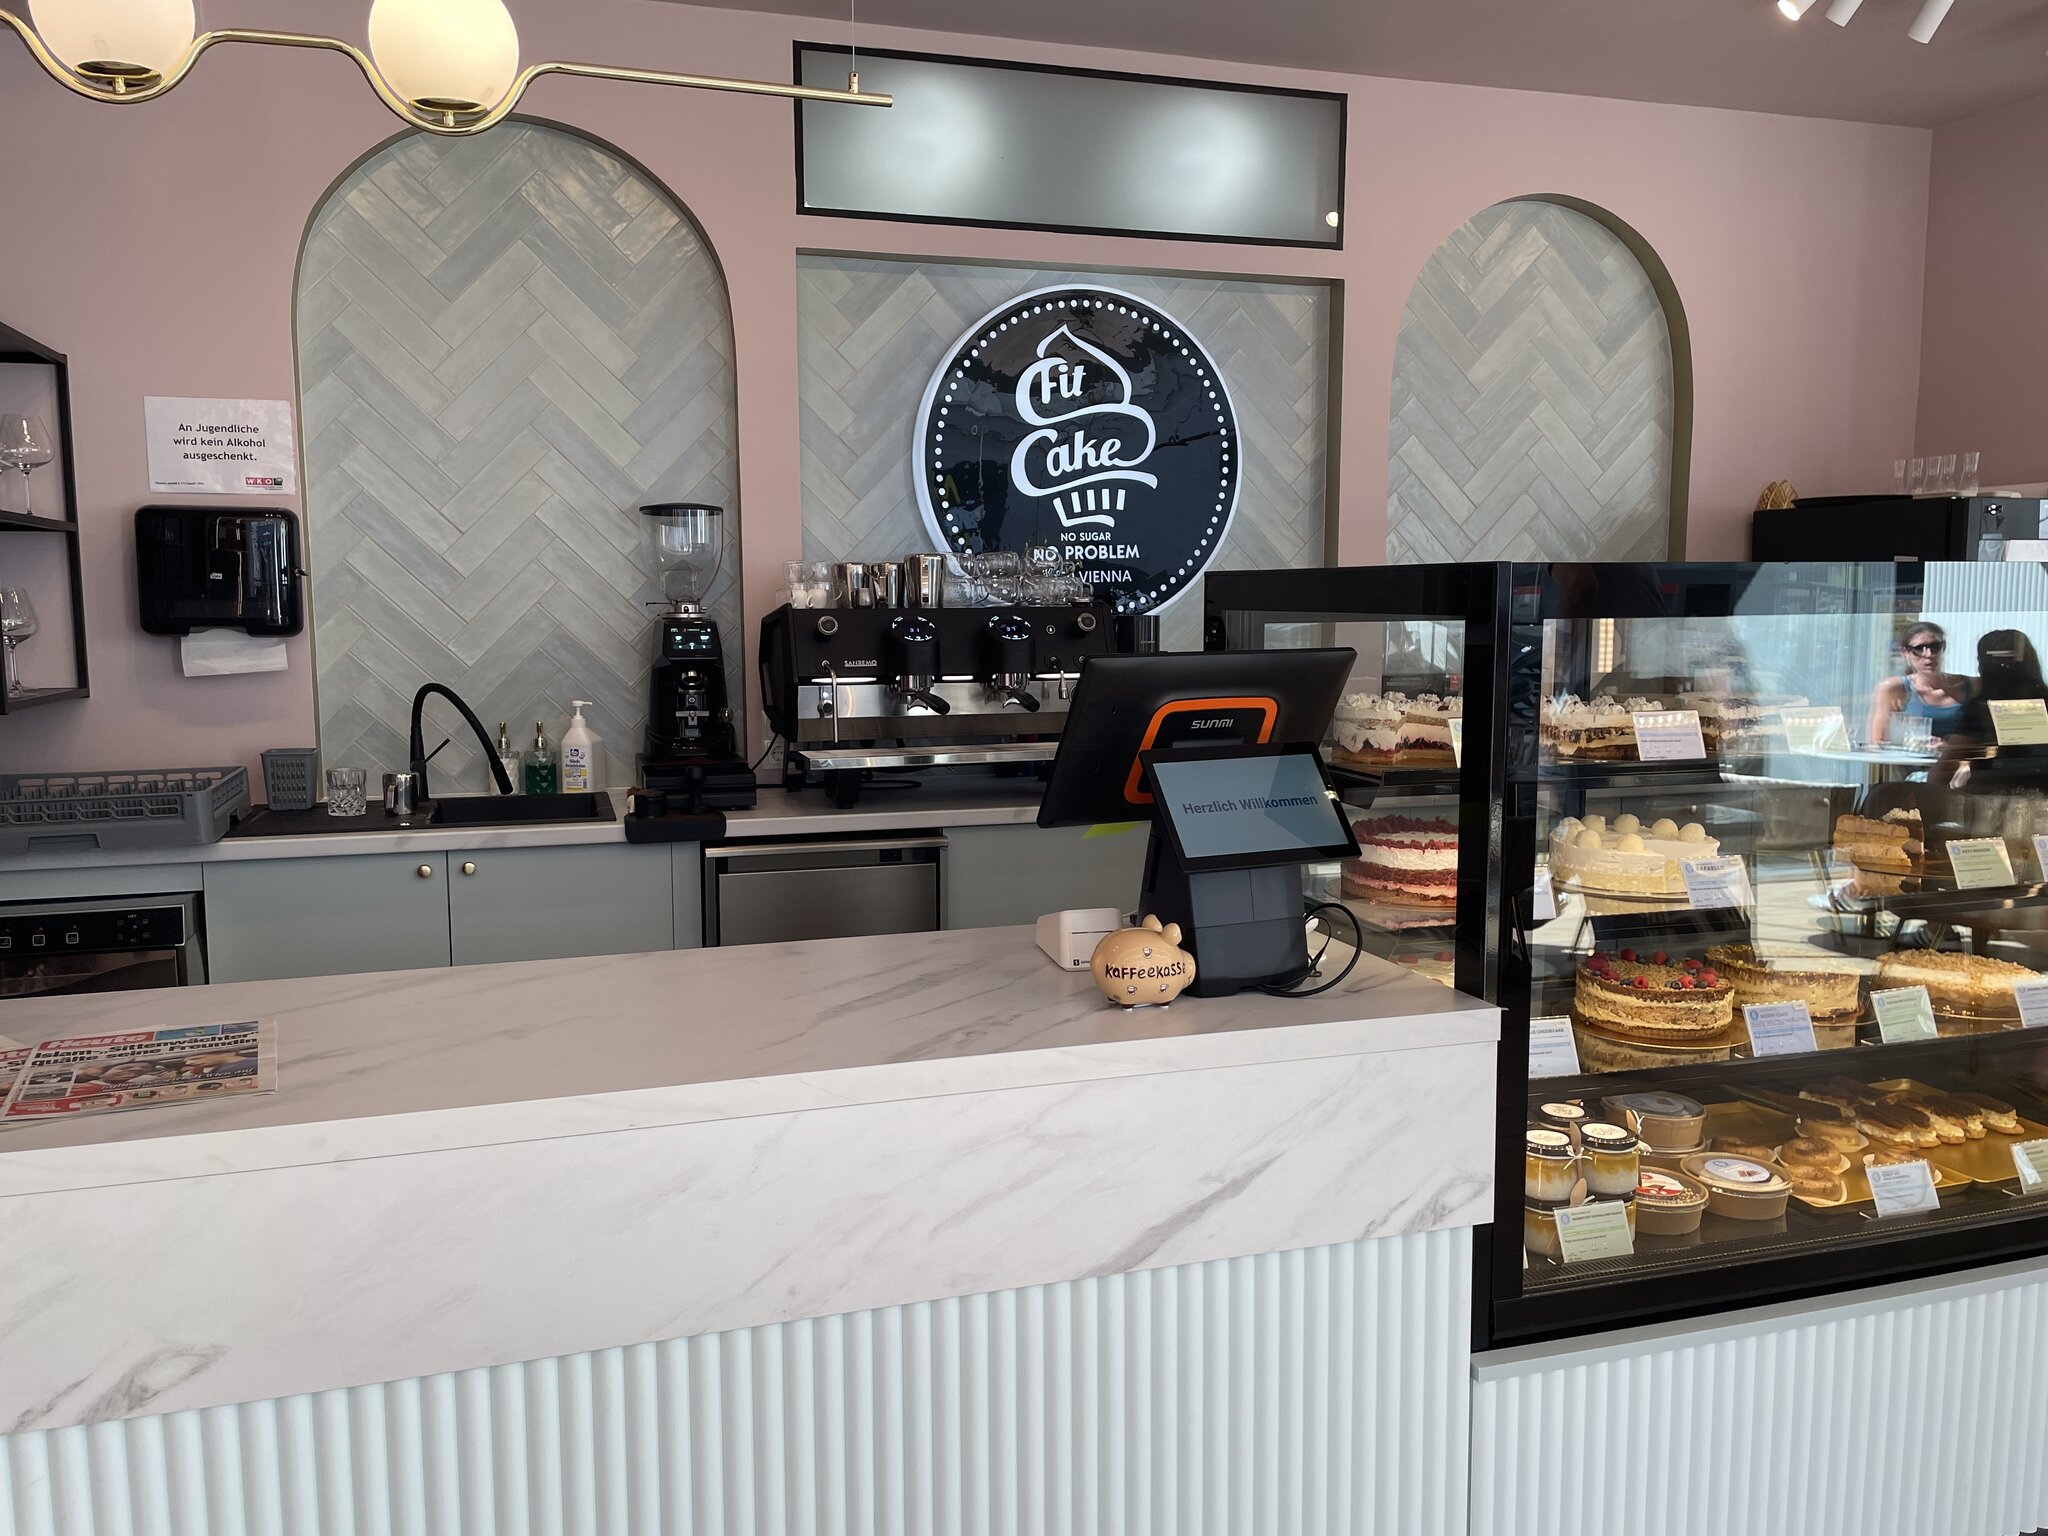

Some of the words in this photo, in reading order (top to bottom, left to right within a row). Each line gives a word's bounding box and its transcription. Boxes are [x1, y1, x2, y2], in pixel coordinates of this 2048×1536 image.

[178, 423, 192, 432] An
[195, 424, 260, 434] Jugendliche
[173, 437, 197, 446] wird
[200, 437, 223, 447] kein
[226, 438, 266, 448] Alkohol
[183, 451, 257, 462] ausgeschenkt.
[1011, 429, 1122, 490] Cake
[1060, 532, 1076, 541] NO
[1079, 531, 1111, 541] SUGAR
[1033, 545, 1059, 561] NO
[1065, 544, 1140, 560] PROBLEM
[1078, 569, 1132, 583] VIENNA
[1182, 800, 1238, 815] Herzlich
[1238, 795, 1319, 811] Willkommen
[46, 1034, 148, 1049] Heute
[105, 1048, 161, 1059] seine
[168, 1038, 258, 1052] Freundin
